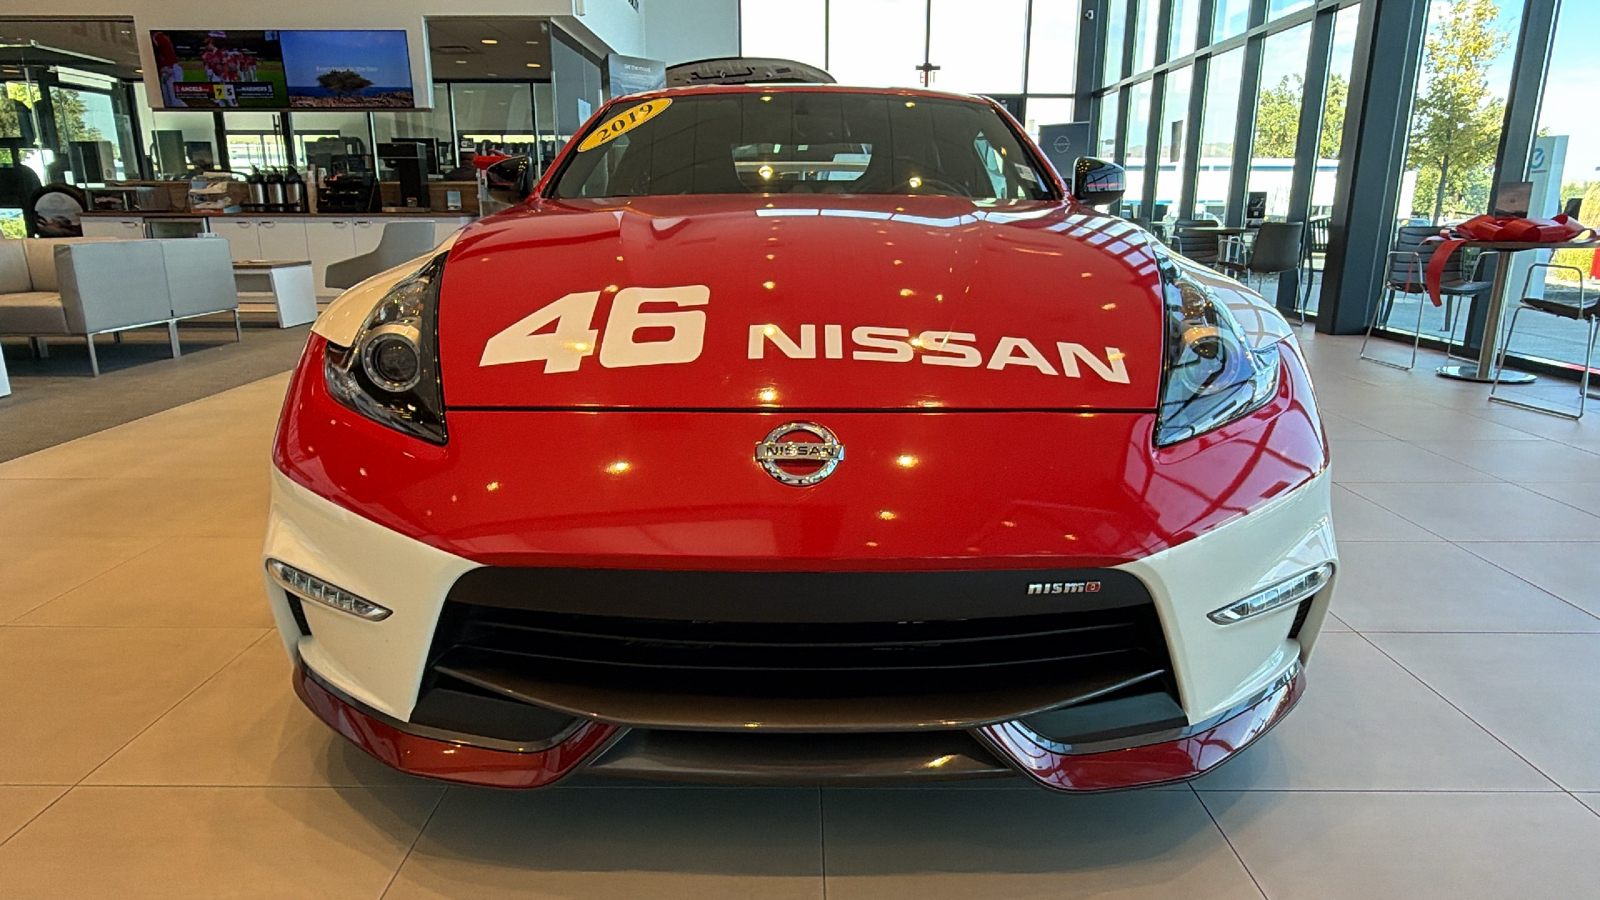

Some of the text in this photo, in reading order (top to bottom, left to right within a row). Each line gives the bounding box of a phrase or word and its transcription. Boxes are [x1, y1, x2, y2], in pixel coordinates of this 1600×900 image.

[216, 88, 222, 96] 7
[226, 88, 233, 96] 5
[597, 104, 653, 142] 2019
[479, 285, 1130, 384] 46 NISSAN
[766, 446, 834, 456] NISSAN
